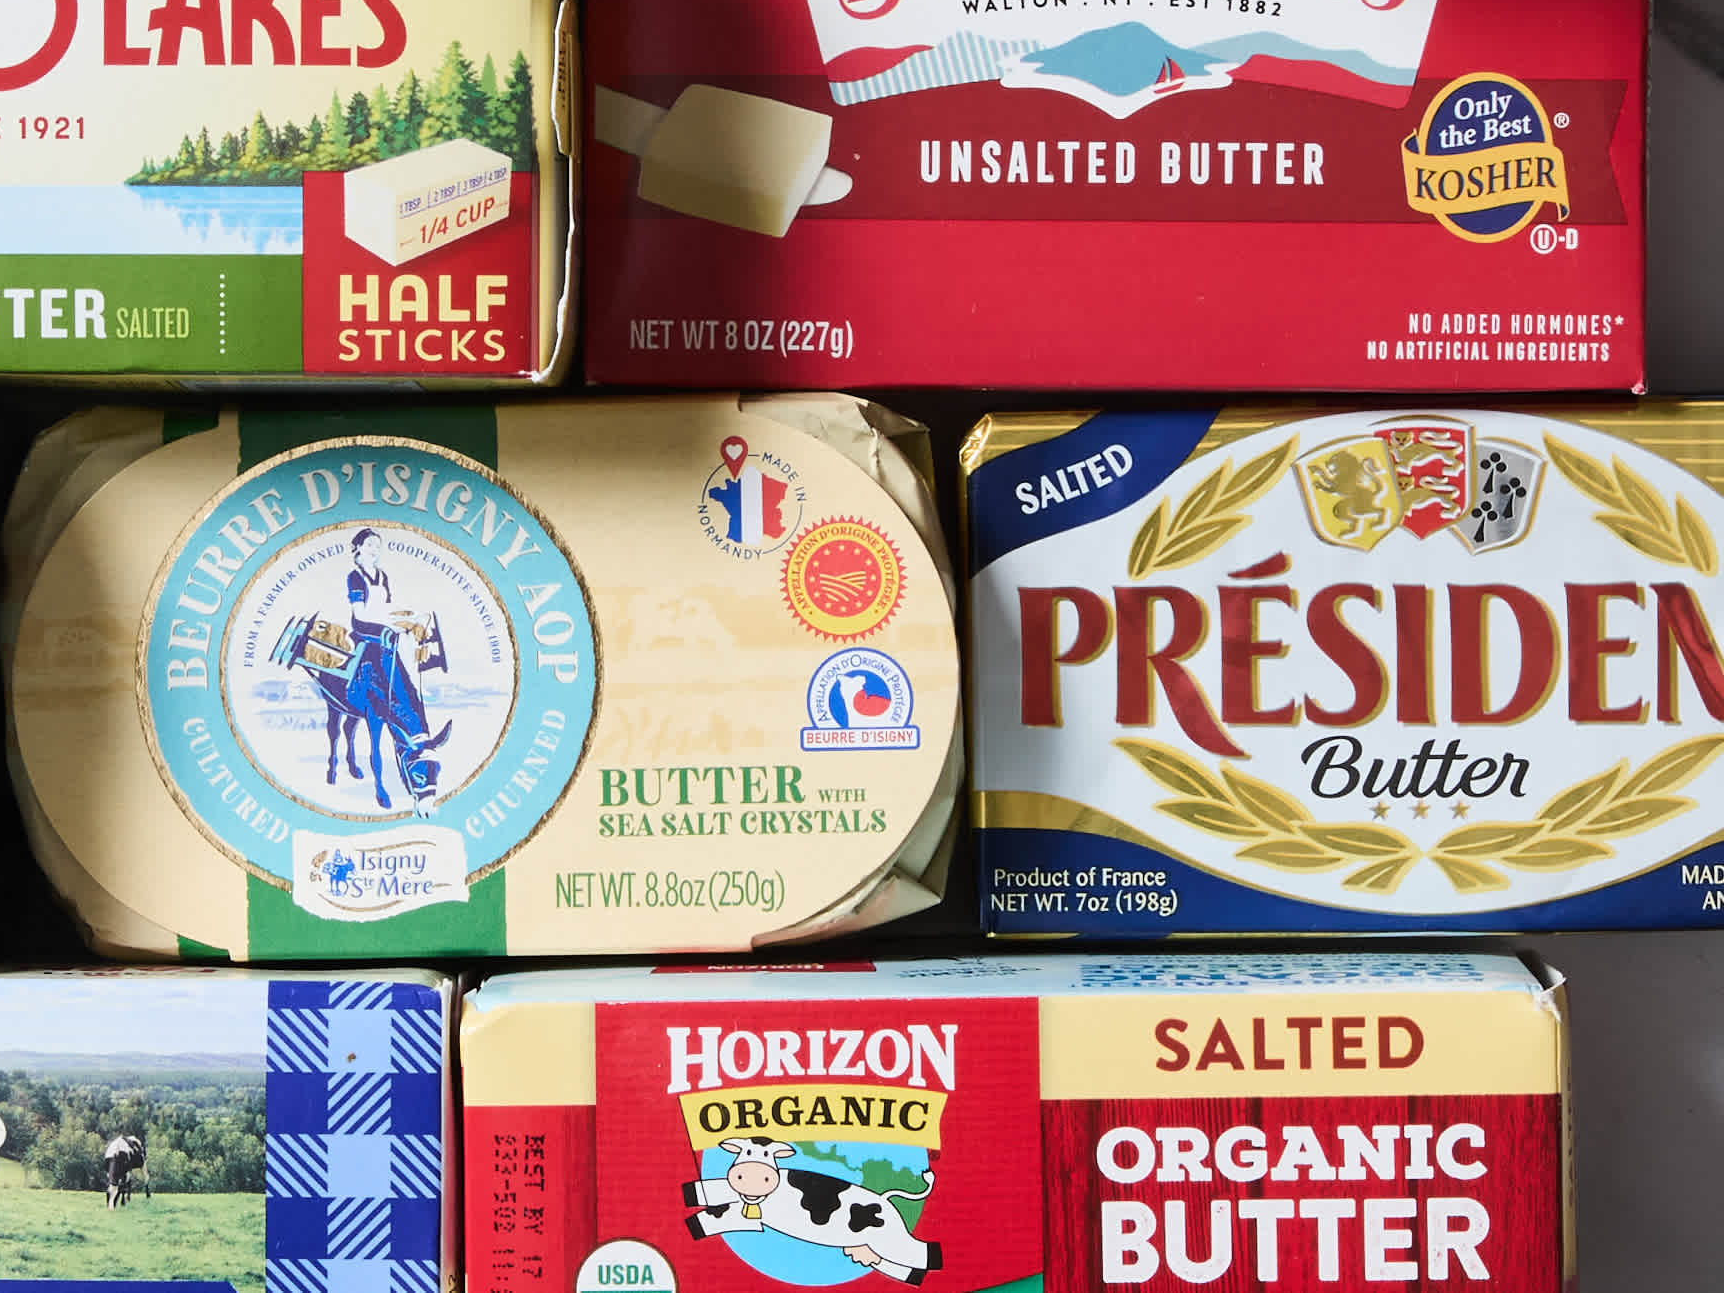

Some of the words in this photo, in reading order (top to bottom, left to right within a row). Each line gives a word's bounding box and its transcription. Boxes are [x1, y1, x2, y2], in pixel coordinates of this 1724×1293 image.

[920, 140, 1136, 183] UNSALTED
[1161, 142, 1325, 185] BUTTER
[117, 308, 190, 338] SALTED
[1015, 444, 1134, 515] SALTED
[168, 488, 296, 692] BEURRE
[517, 578, 579, 685] AOP
[182, 716, 290, 846] CULTURED
[464, 709, 566, 839] CHURNED
[600, 765, 806, 807] BUTTER
[818, 789, 866, 803] WITH
[1301, 735, 1530, 799] Butter
[599, 813, 654, 837] SEA
[661, 813, 731, 837] SALT
[740, 808, 887, 835] CRYSTALS
[360, 850, 428, 878] Isigny
[994, 868, 1070, 890] Product
[1076, 868, 1099, 888] of
[1103, 867, 1166, 888] France
[991, 892, 1031, 912] NET
[1036, 892, 1070, 912] WT.
[1076, 892, 1111, 912] 7oz
[1116, 889, 1179, 915] (198g)
[667, 1025, 958, 1094] HORIZON
[1154, 1016, 1424, 1072] SALTED
[699, 1095, 930, 1132] ORGANIC
[1096, 1123, 1488, 1184] ORGANIC
[1101, 1197, 1491, 1284] BUTTER
[598, 1265, 655, 1286] USDA
